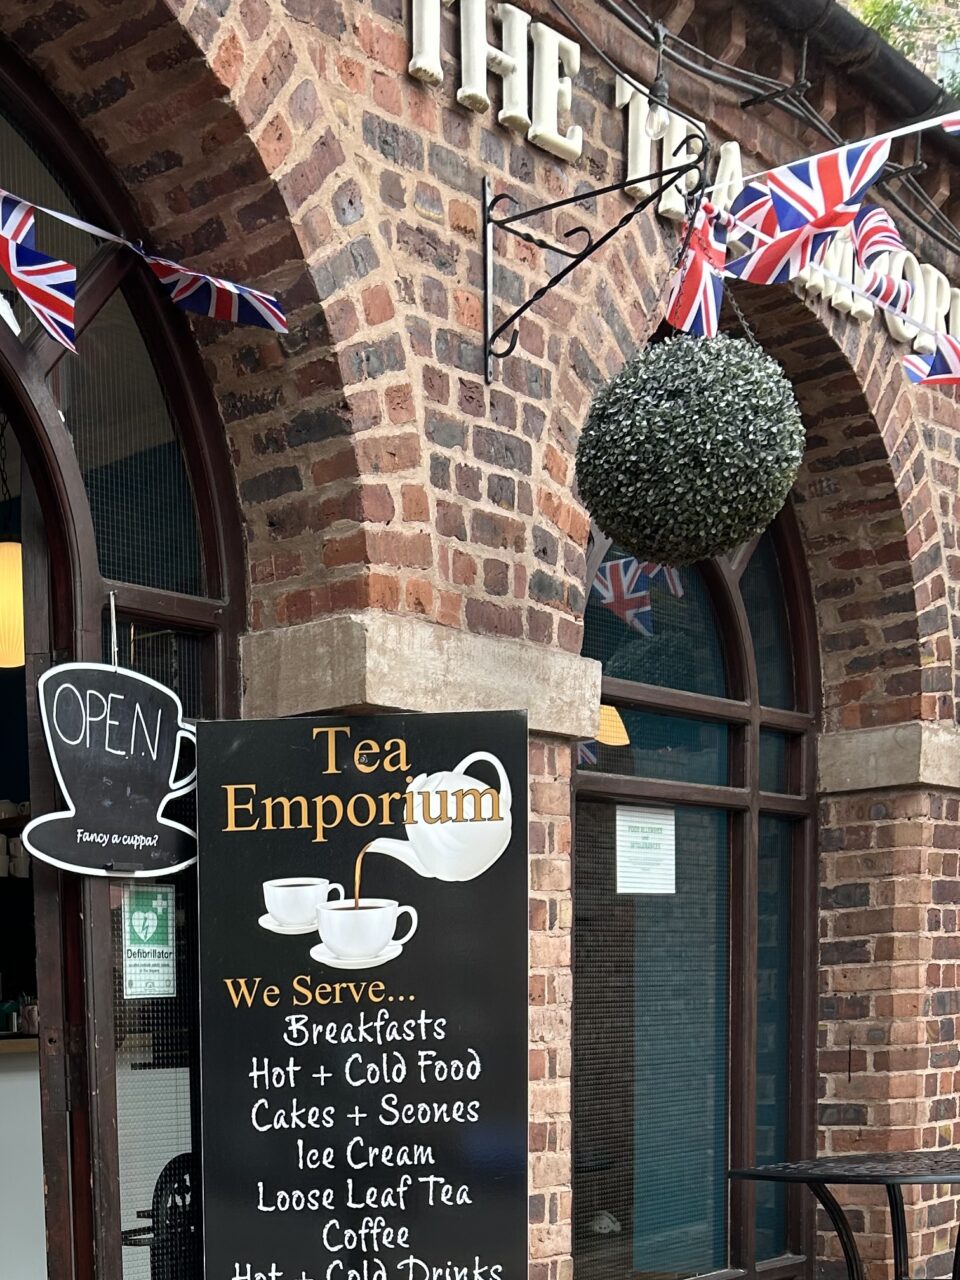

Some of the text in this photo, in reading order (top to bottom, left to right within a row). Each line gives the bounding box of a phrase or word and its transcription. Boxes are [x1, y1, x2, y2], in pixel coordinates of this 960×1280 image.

[53, 683, 162, 761] OPEN
[312, 725, 412, 775] Tea
[221, 775, 504, 843] Emporium
[76, 828, 160, 850] Fancy a cuppa?
[127, 948, 174, 959] Defibrillator
[223, 974, 416, 1008] We Serve...
[282, 1008, 447, 1048] Breakfasts
[248, 1047, 482, 1090] Hot + Cold Food
[251, 1092, 481, 1133] Cakes + Scones
[296, 1135, 436, 1170] Ice Cream
[256, 1174, 473, 1213] Loose Leaf Tea
[321, 1216, 411, 1253] Coffee
